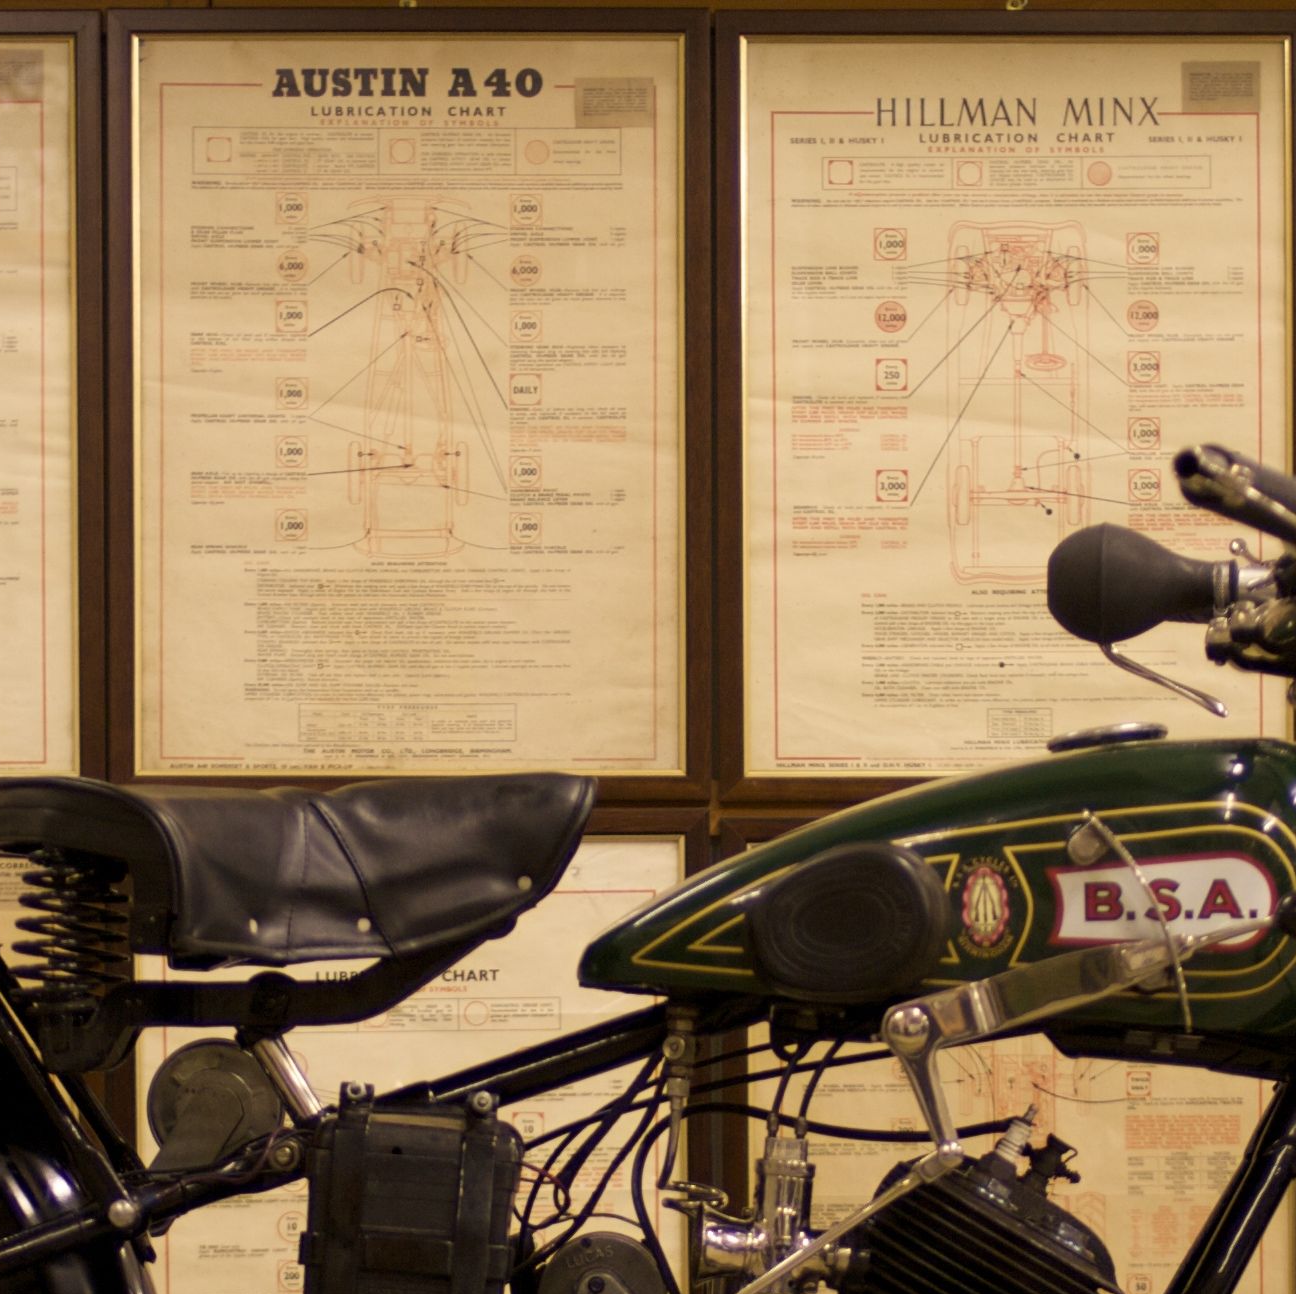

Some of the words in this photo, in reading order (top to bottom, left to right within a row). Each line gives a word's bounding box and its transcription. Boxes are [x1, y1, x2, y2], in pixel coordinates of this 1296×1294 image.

[272, 67, 429, 97] AUSTIN
[448, 67, 543, 97] A40
[310, 105, 433, 117] LUBRICATION
[448, 105, 507, 117] CHART
[876, 97, 1037, 127] HILLMAN
[1063, 97, 1160, 126] MINX
[319, 119, 410, 127] EXPLANATION
[790, 137, 817, 145] SERIES
[848, 137, 878, 145] HUSKY
[919, 132, 1038, 144] LUBRICATION
[1056, 132, 1115, 143] CHART
[1148, 136, 1175, 144] SERIES
[883, 371, 901, 381] 250
[512, 385, 539, 396] DAILY
[1083, 878, 1260, 923] B.S.A.
[442, 969, 500, 982] CHART
[565, 1244, 615, 1269] LUCAS
